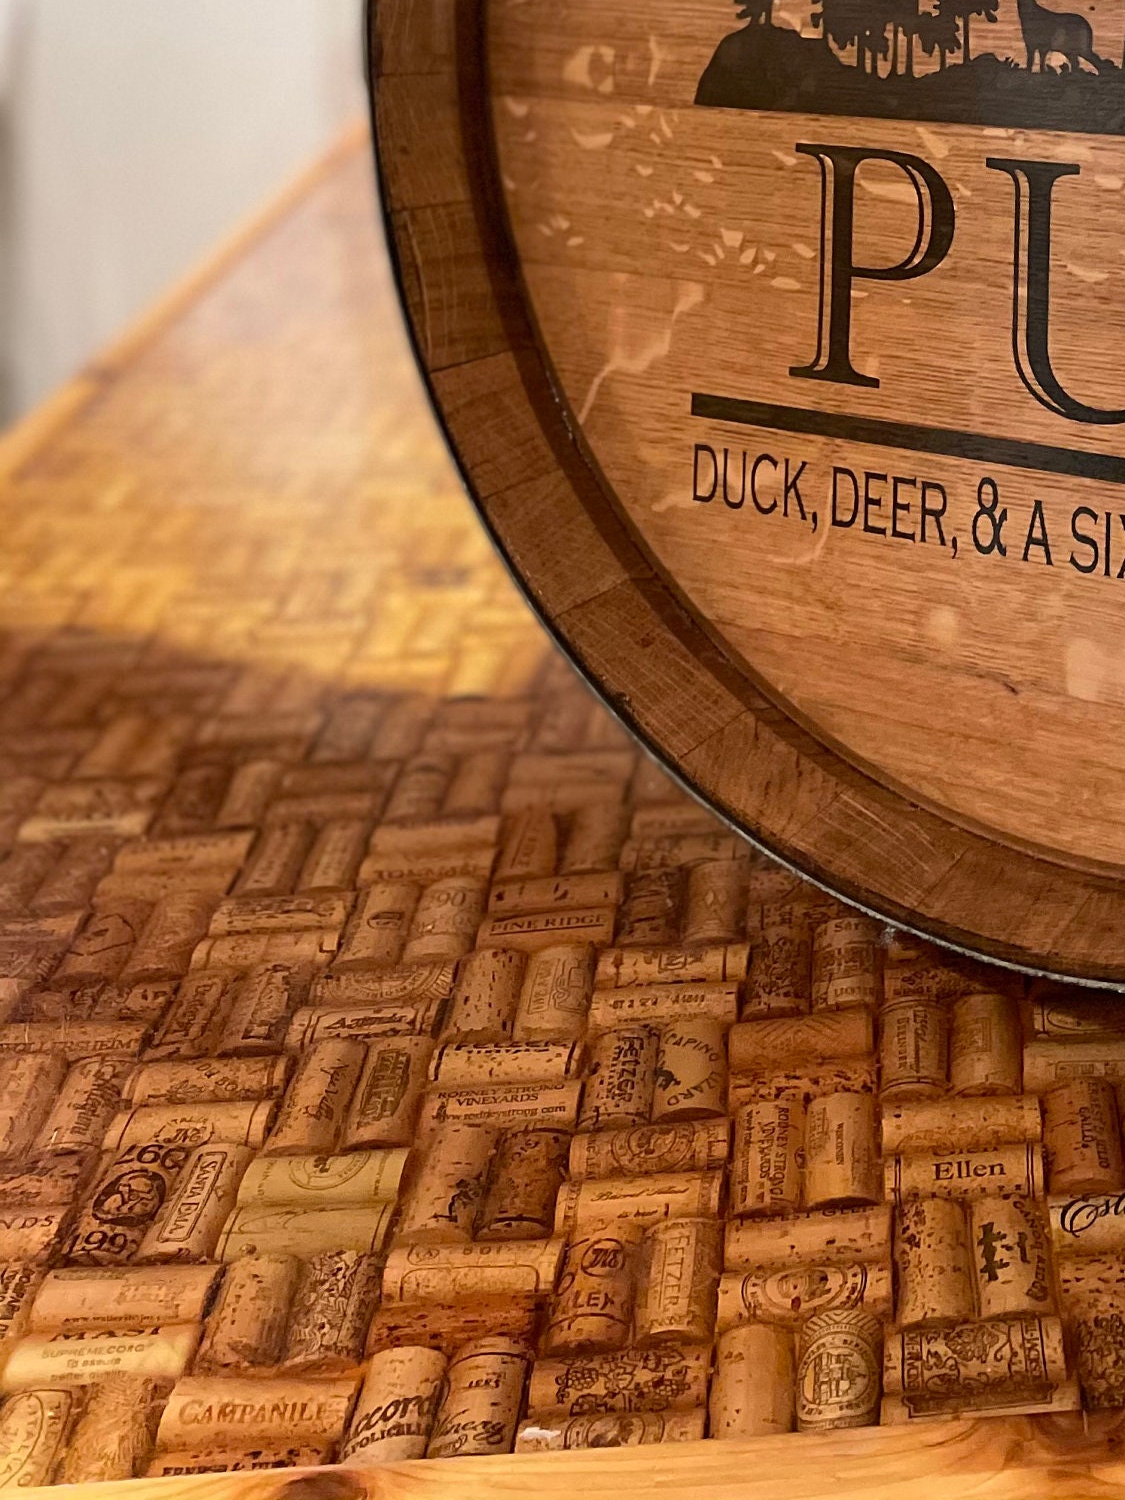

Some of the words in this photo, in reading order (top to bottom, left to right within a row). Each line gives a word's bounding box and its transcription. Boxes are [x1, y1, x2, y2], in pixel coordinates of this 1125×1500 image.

[691, 443, 819, 534] DUCK,
[831, 465, 959, 560] DEER,
[971, 477, 1009, 558] &
[1022, 500, 1054, 567] A
[543, 914, 609, 928] RIDGE
[437, 1088, 498, 1100] RODNEY
[503, 1083, 565, 1095] STRONG
[456, 1092, 539, 1107] VINEYARDS
[931, 1159, 1007, 1182] Ellen
[178, 1398, 330, 1426] CAMPANILE
